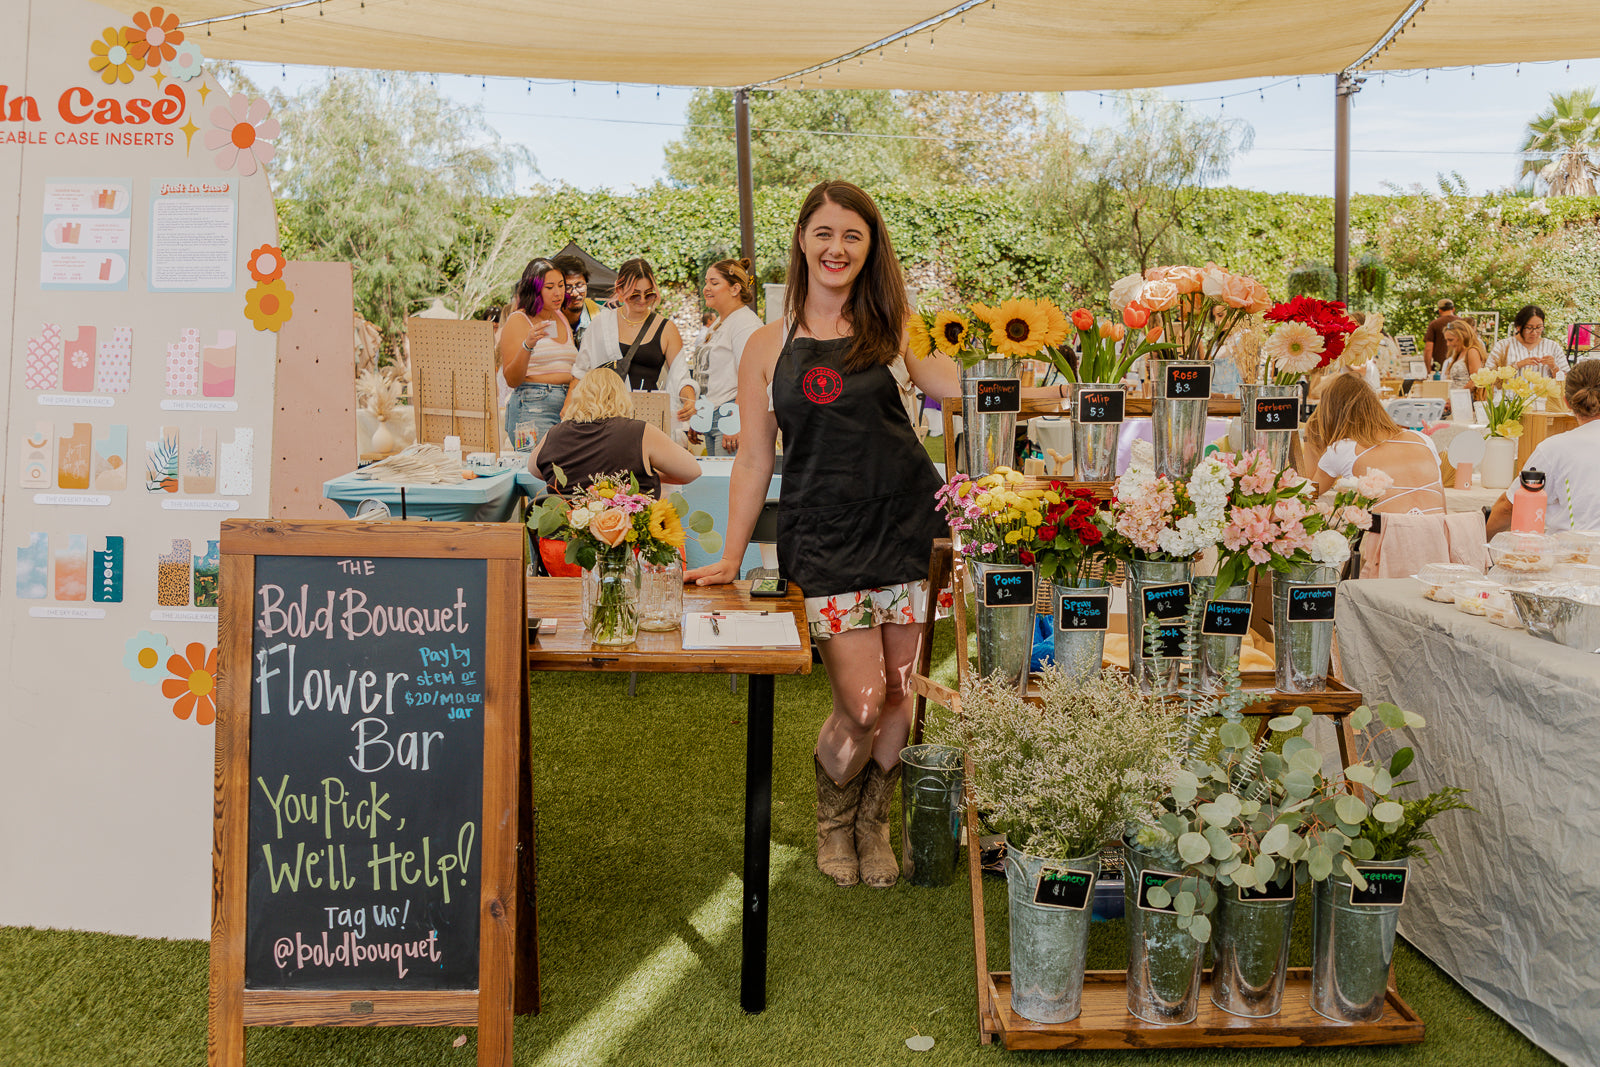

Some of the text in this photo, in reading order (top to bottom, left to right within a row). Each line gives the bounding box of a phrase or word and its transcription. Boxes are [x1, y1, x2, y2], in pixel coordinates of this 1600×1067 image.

[58, 84, 186, 125] Case
[55, 132, 99, 145] CASE
[105, 132, 174, 146] INSERTS
[160, 183, 186, 196] Just
[201, 183, 230, 193] Case
[1172, 370, 1198, 381] Rose
[978, 383, 1017, 394] Sunflower
[1175, 382, 1190, 393] $3
[985, 395, 1001, 407] $3
[1084, 393, 1110, 406] Tulip
[1090, 407, 1105, 418] $3
[1266, 413, 1280, 422] $3
[337, 560, 375, 576] THE
[997, 588, 1012, 599] $2
[1146, 588, 1184, 601] Berries
[1063, 599, 1091, 611] Spray
[1157, 601, 1172, 612] $2
[1303, 601, 1317, 611] $2
[1077, 608, 1101, 616] Rose
[1072, 616, 1088, 627] $2
[1216, 616, 1232, 627] $2
[1150, 628, 1179, 638] ock
[418, 642, 471, 668] Pay by
[256, 642, 409, 716] Flower
[461, 671, 477, 682] or
[349, 717, 444, 773] Bar
[257, 774, 405, 839] You Pick,
[262, 821, 475, 903] We'll Help!
[1362, 872, 1402, 883] reenery
[324, 906, 366, 939] Tag
[274, 930, 442, 979] @boldbouquet
